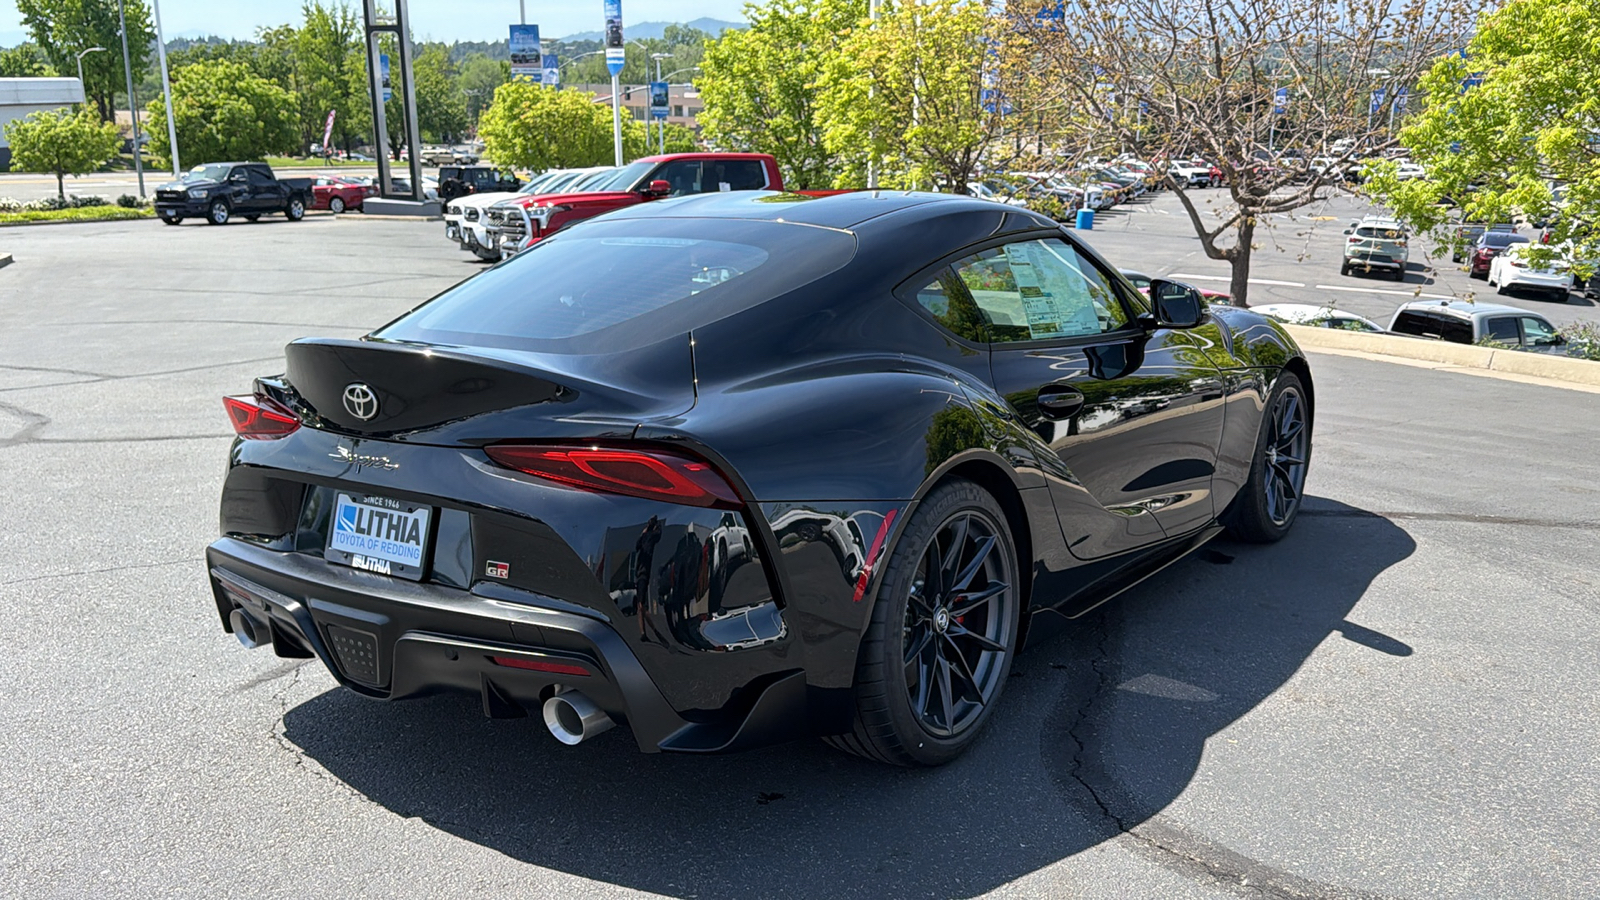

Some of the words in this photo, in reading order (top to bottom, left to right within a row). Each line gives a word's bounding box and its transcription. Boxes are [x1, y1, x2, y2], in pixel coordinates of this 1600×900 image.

[363, 496, 383, 506] SINCE
[384, 499, 400, 509] 1946
[355, 508, 421, 546] LITHIA
[335, 532, 365, 549] TOYOTA
[367, 540, 379, 550] OF
[380, 542, 420, 560] REDDING
[361, 556, 391, 575] LITHIA
[487, 566, 508, 577] GR
